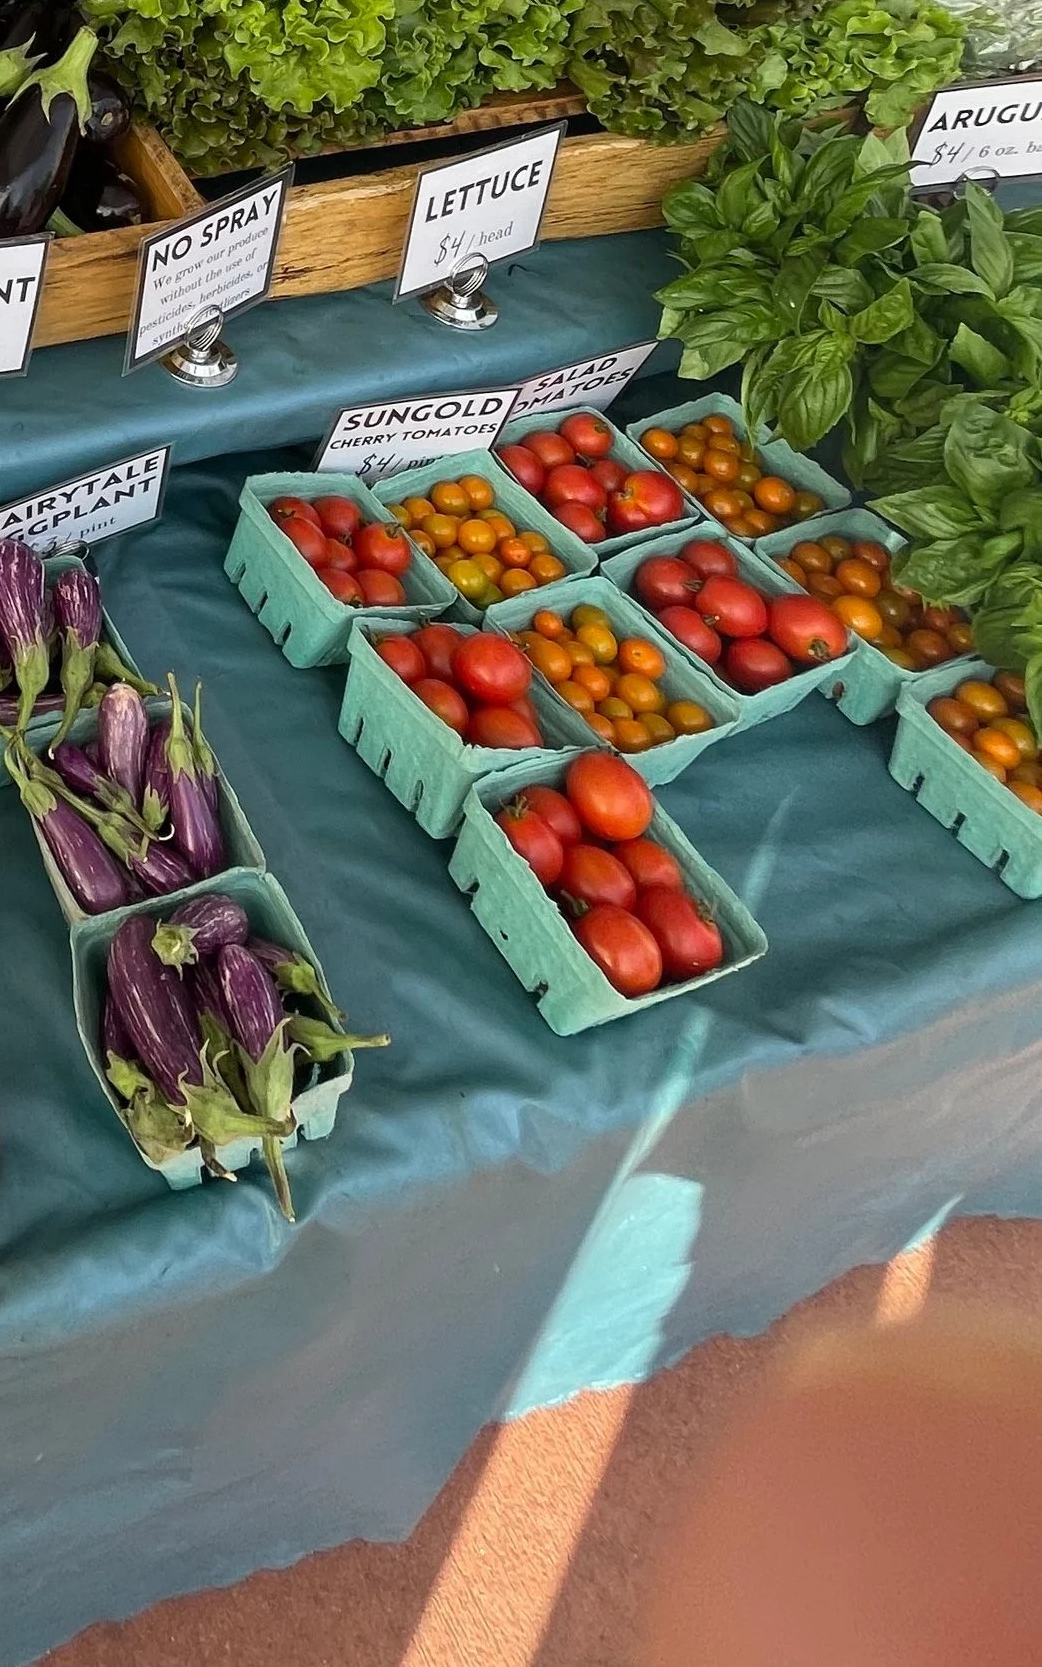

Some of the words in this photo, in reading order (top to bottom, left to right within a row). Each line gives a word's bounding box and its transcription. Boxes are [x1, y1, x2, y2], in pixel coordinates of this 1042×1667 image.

[927, 102, 1042, 133] ARUGU
[929, 141, 965, 168] $4
[979, 145, 991, 158] 6
[995, 146, 1019, 157] oz.
[425, 160, 543, 223] LETTUCE
[152, 235, 192, 272] NO
[200, 190, 278, 248] SPRAY
[434, 230, 466, 267] $4
[478, 221, 513, 247] head
[153, 274, 172, 291] We
[174, 259, 204, 285] grow
[206, 248, 226, 264] our
[227, 227, 269, 256] produce
[160, 278, 202, 306] without
[205, 268, 222, 284] the
[225, 259, 243, 273] use
[245, 247, 258, 261] of
[139, 300, 196, 338] pesticides,
[199, 269, 254, 304] herbicides,
[256, 261, 269, 275] or
[533, 357, 618, 393] SALAD
[343, 397, 504, 431] SUNGOLD
[329, 433, 397, 451] CHERRY
[402, 423, 498, 441] TOMATOES
[355, 453, 395, 477] $4
[80, 515, 116, 539] pint
